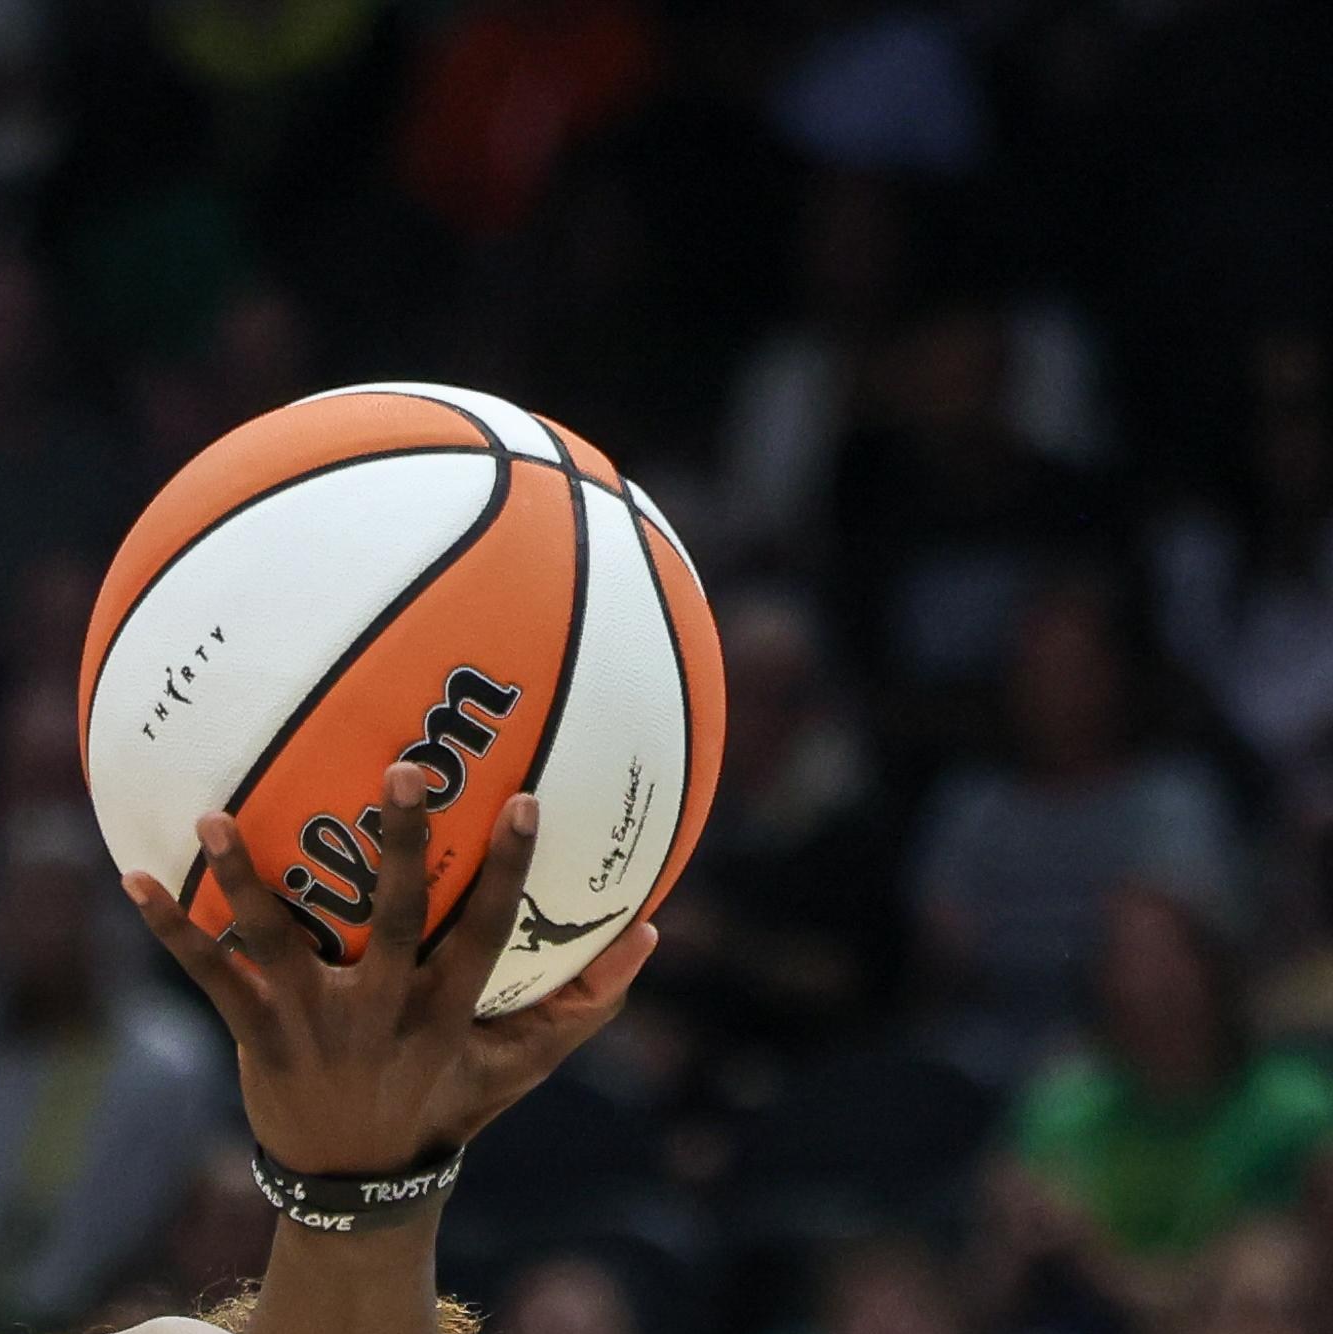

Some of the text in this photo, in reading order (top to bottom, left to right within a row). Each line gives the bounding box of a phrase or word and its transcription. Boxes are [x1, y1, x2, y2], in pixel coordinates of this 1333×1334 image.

[217, 665, 522, 968] ilon
[360, 1173, 438, 1203] TRUST
[287, 1206, 356, 1232] LOVE
